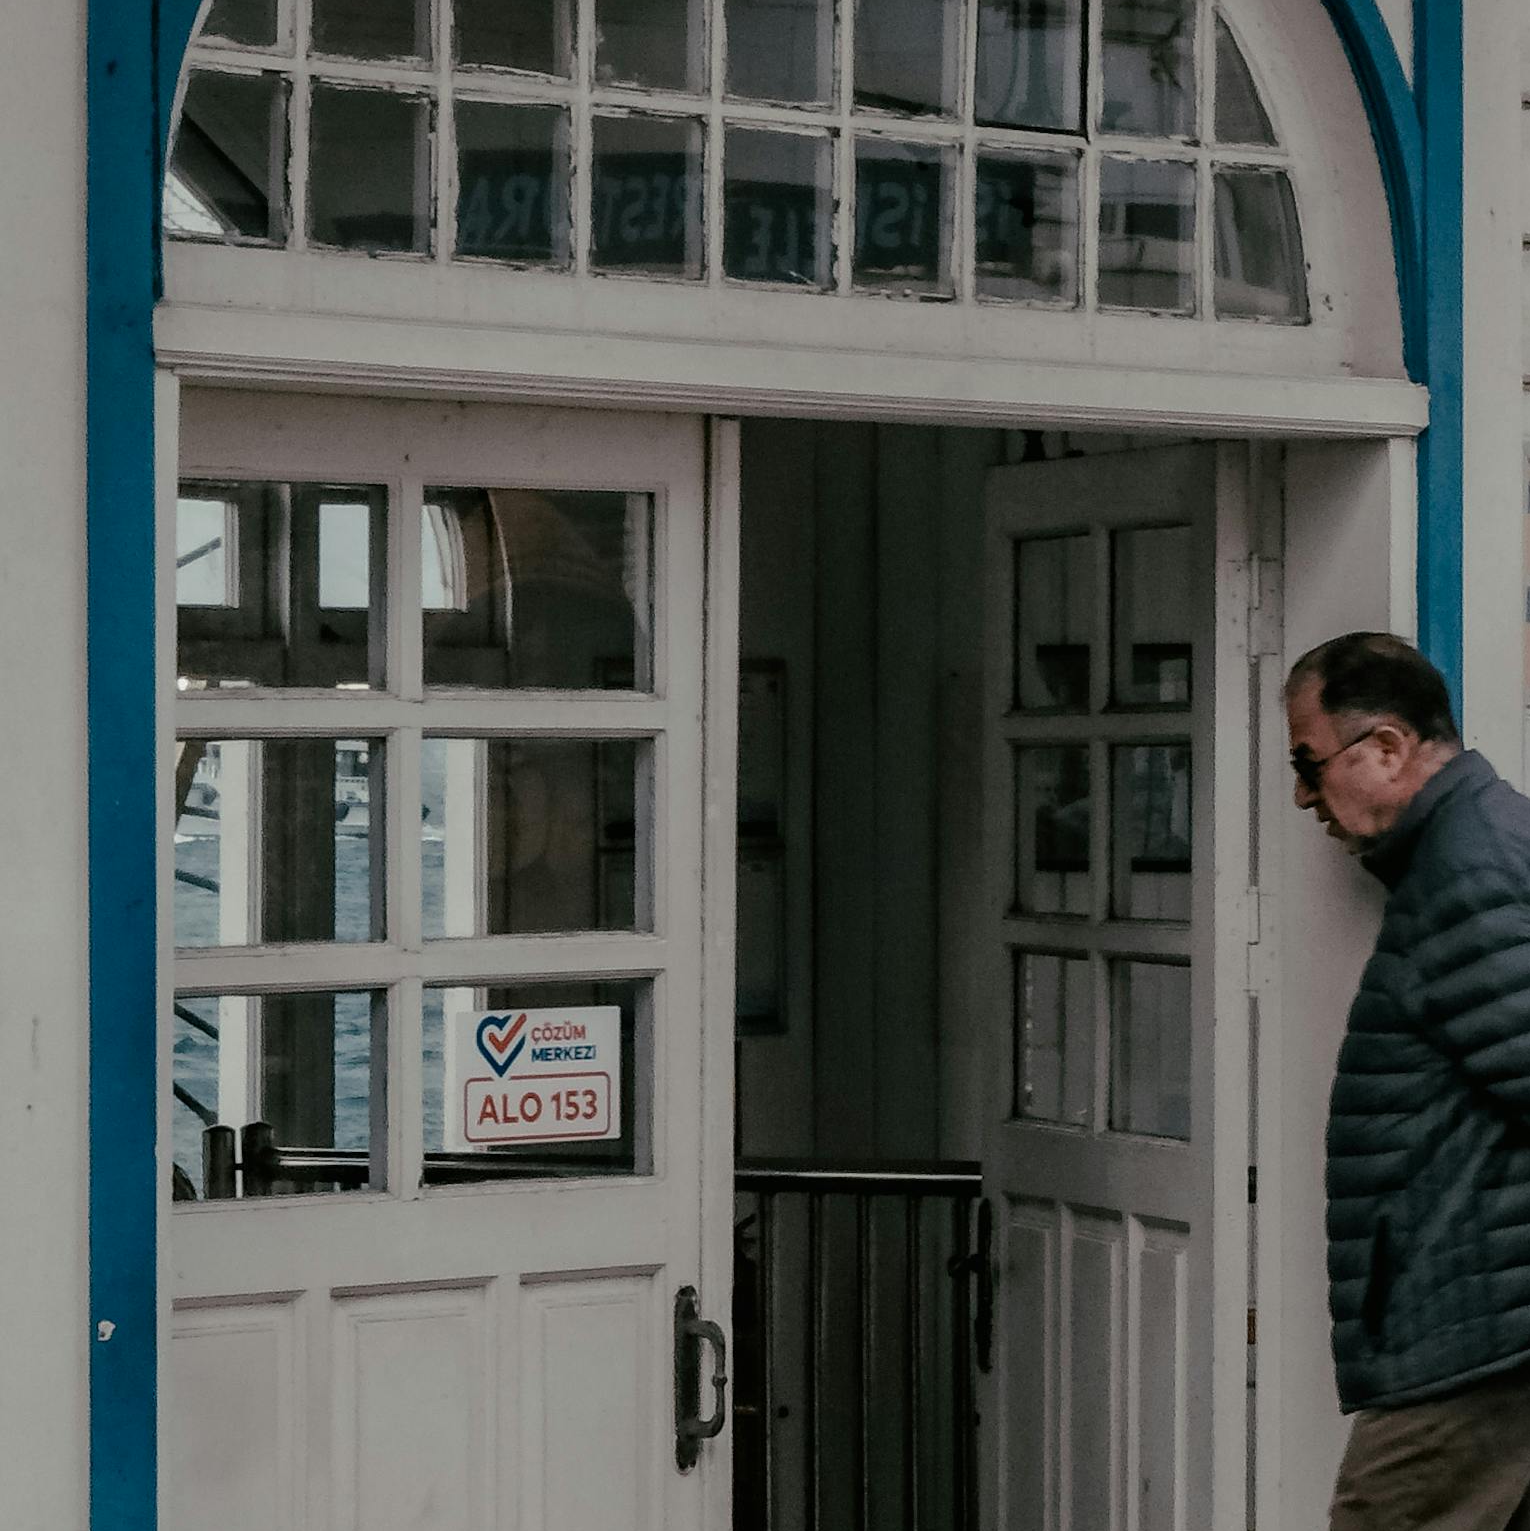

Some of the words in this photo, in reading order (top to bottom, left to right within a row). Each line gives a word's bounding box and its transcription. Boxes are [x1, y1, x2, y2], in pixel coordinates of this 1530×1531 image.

[531, 1020, 587, 1044] ÇÖZÜM
[476, 1092, 543, 1126] ALO
[551, 1089, 598, 1122] 153
